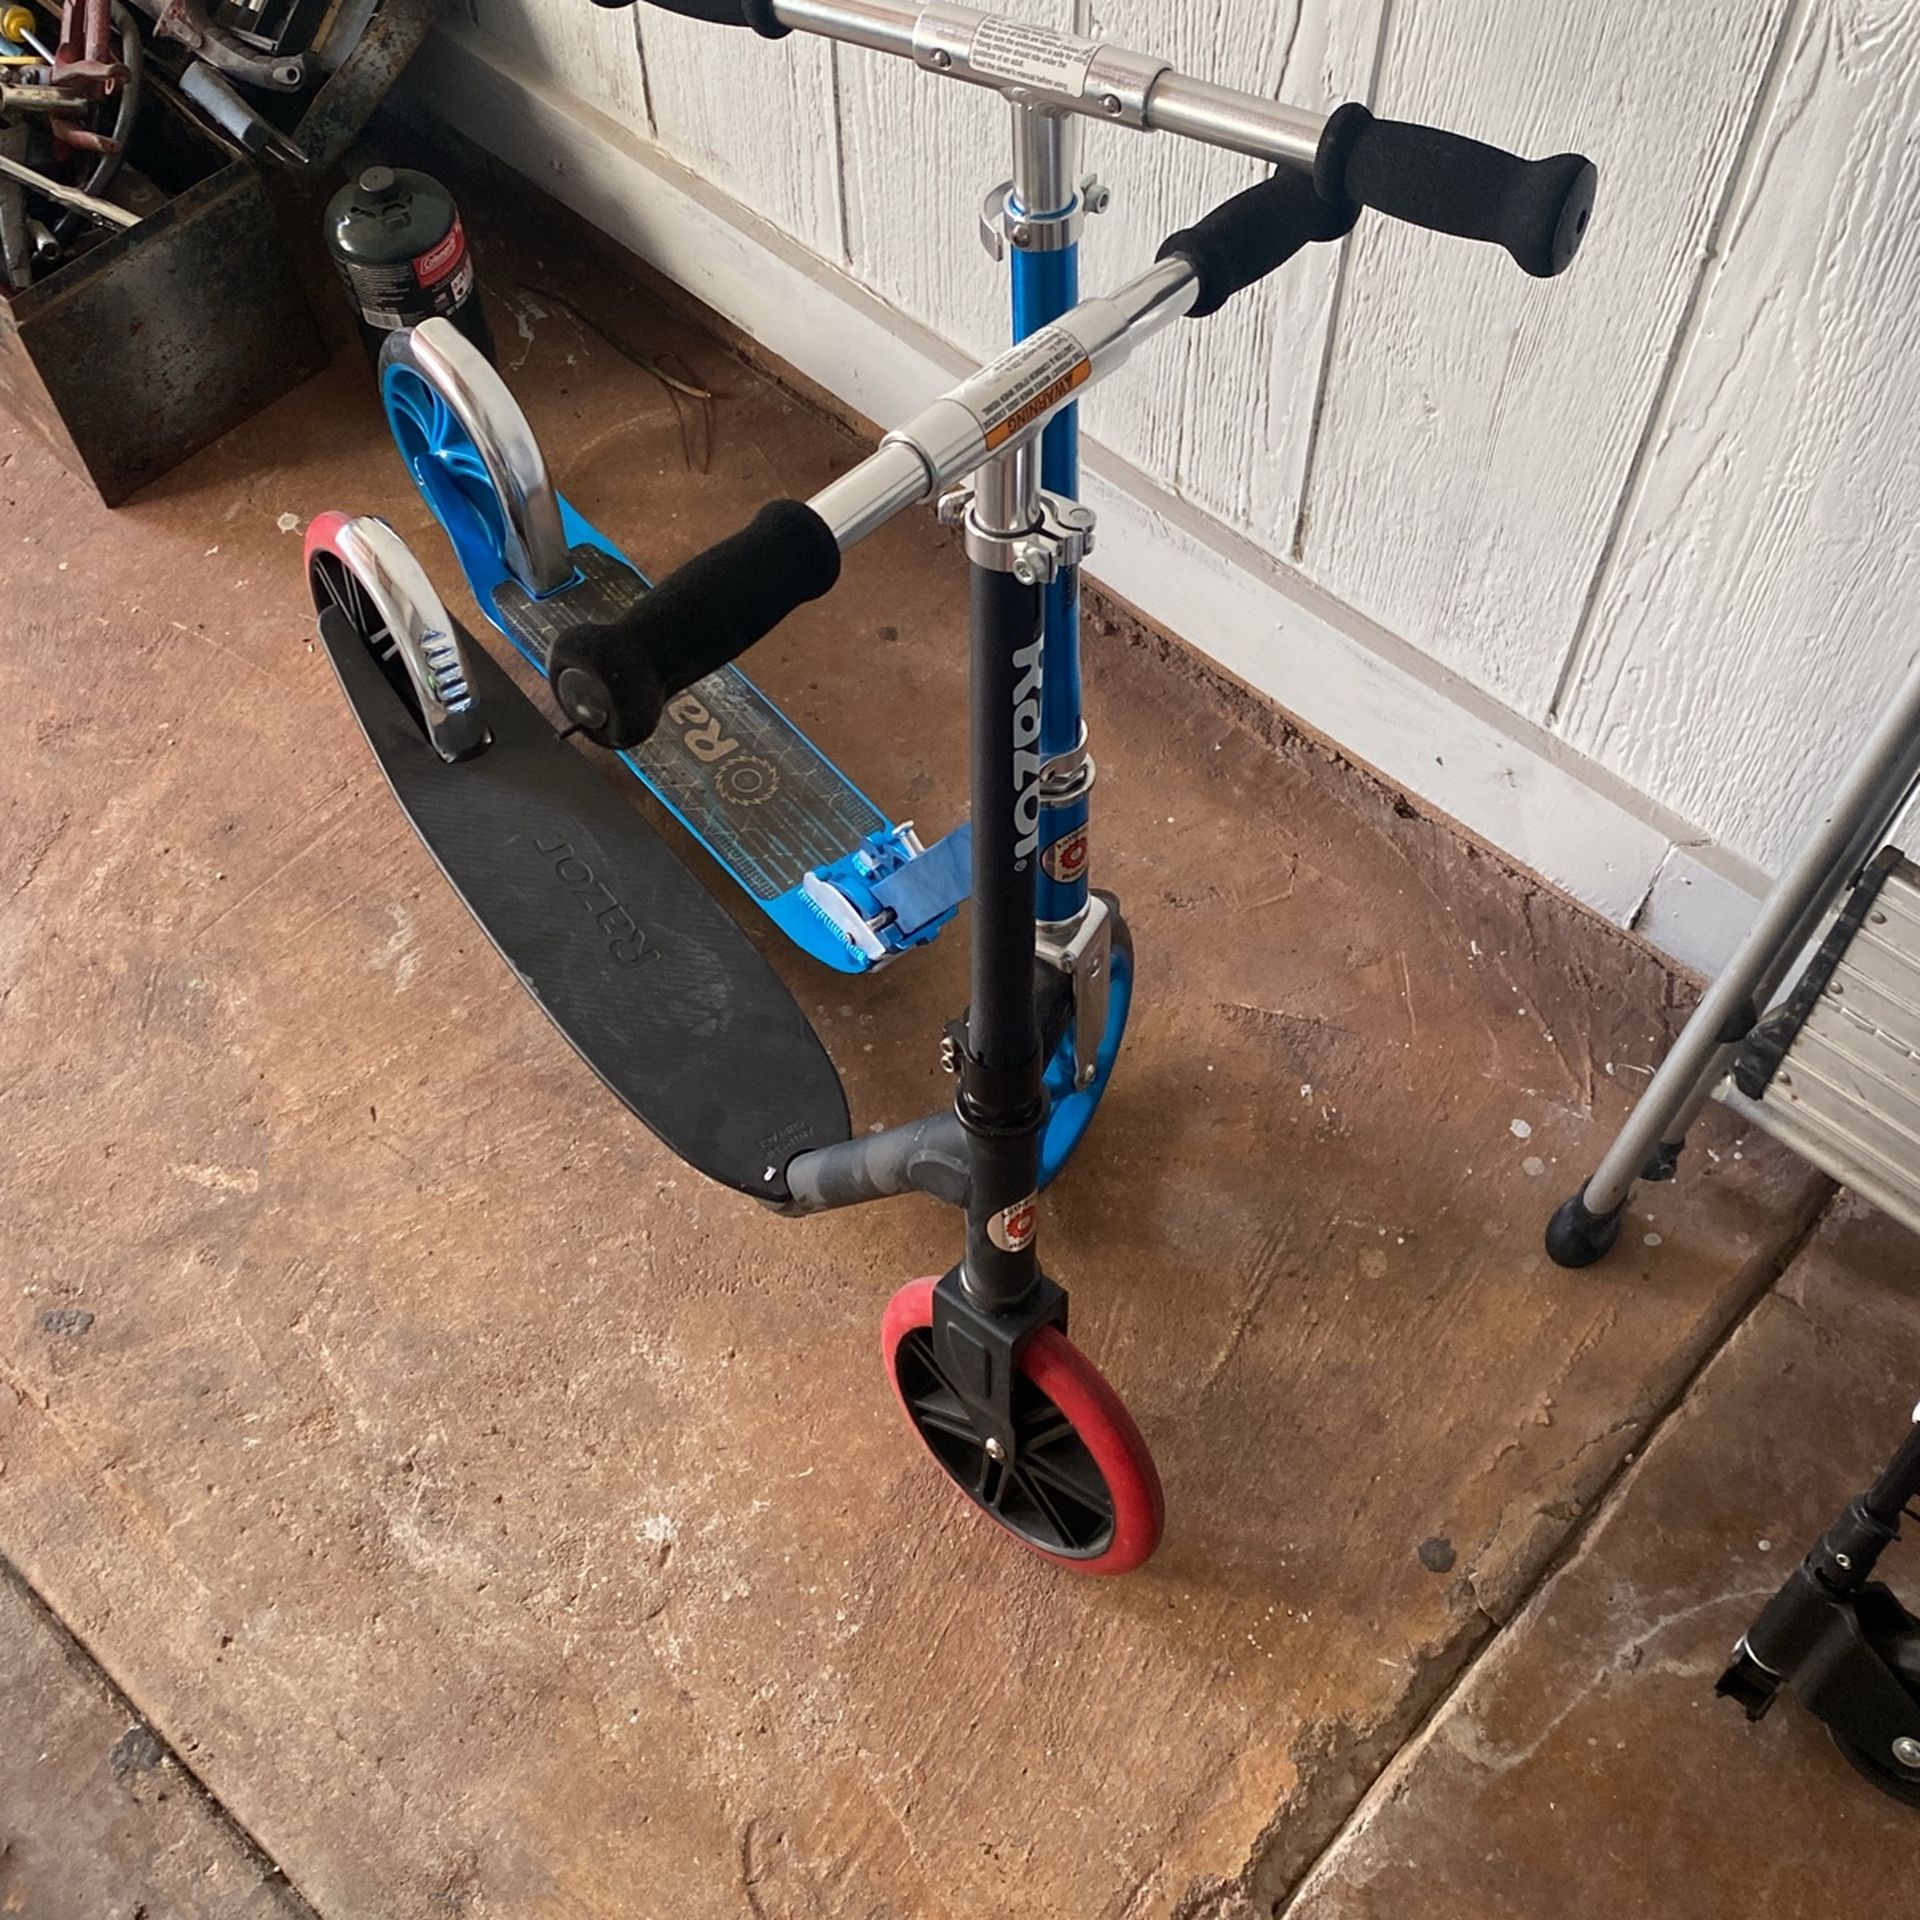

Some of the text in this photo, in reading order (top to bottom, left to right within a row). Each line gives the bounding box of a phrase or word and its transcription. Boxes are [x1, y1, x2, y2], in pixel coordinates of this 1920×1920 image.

[1005, 379, 1070, 432] WARNING
[667, 688, 739, 762] Ra
[533, 836, 662, 970] Razor
